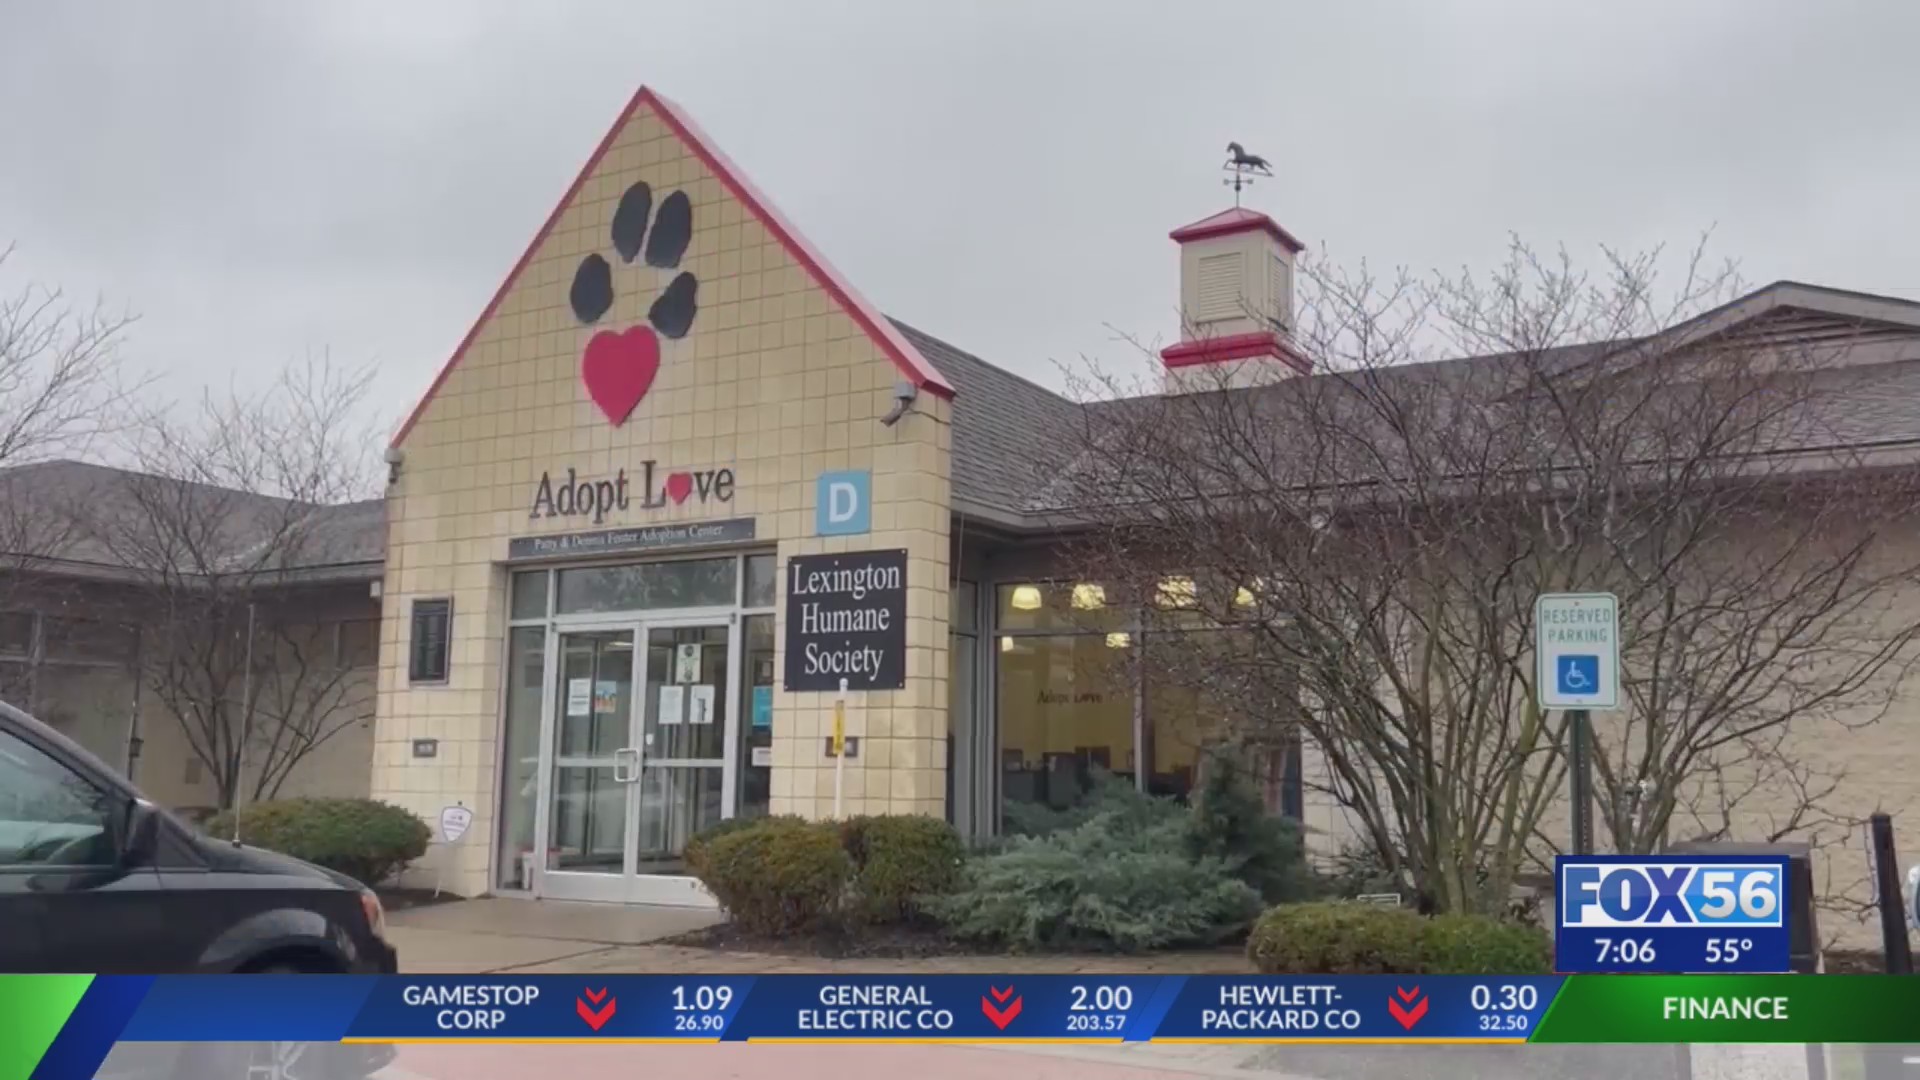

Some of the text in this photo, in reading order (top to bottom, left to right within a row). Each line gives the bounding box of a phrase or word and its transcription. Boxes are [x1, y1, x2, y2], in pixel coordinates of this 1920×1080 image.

[529, 467, 630, 524] Adopt
[829, 482, 858, 523] D
[640, 526, 687, 545] Adoption
[689, 524, 724, 538] Center
[792, 560, 901, 600] Lexington
[801, 602, 890, 634] Humane
[1543, 608, 1611, 625] RESERVED
[1547, 627, 1608, 643] PARKING
[804, 640, 884, 681] Society
